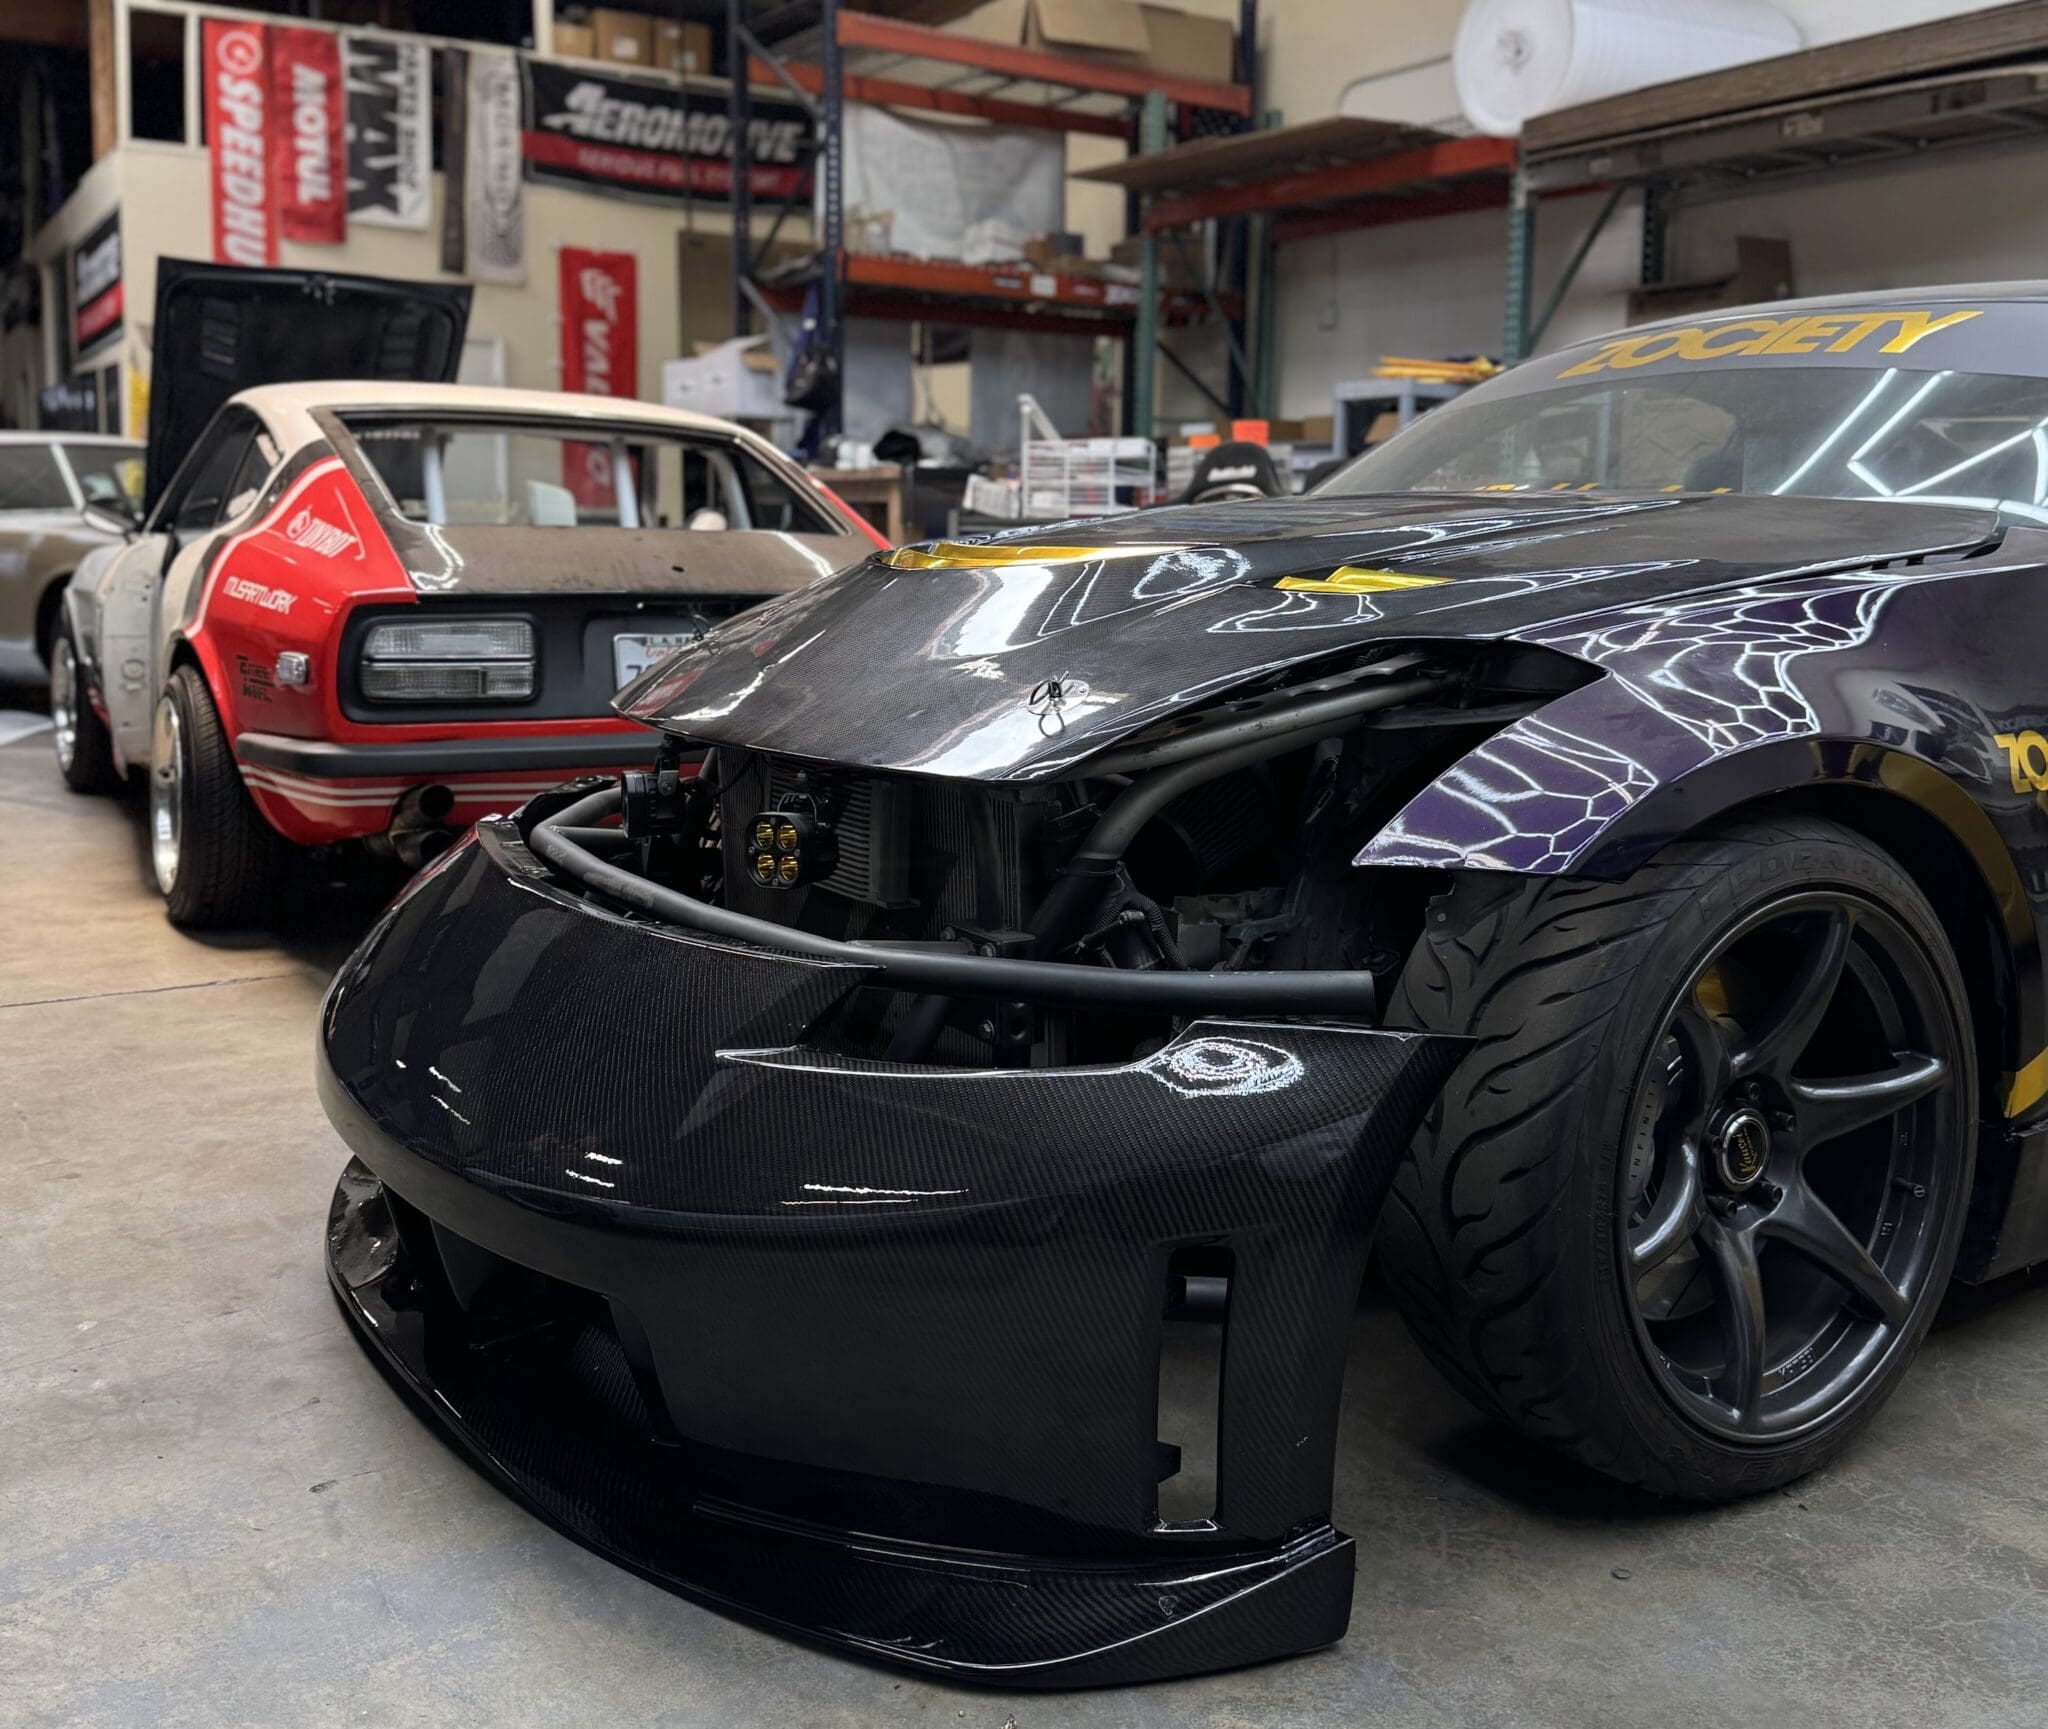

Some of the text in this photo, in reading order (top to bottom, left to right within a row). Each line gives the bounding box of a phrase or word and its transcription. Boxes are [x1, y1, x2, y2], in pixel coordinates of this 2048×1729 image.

[292, 60, 332, 205] MOTUL
[1556, 311, 1984, 379] ZOCIETY
[1630, 1079, 1657, 1178] INFINITI
